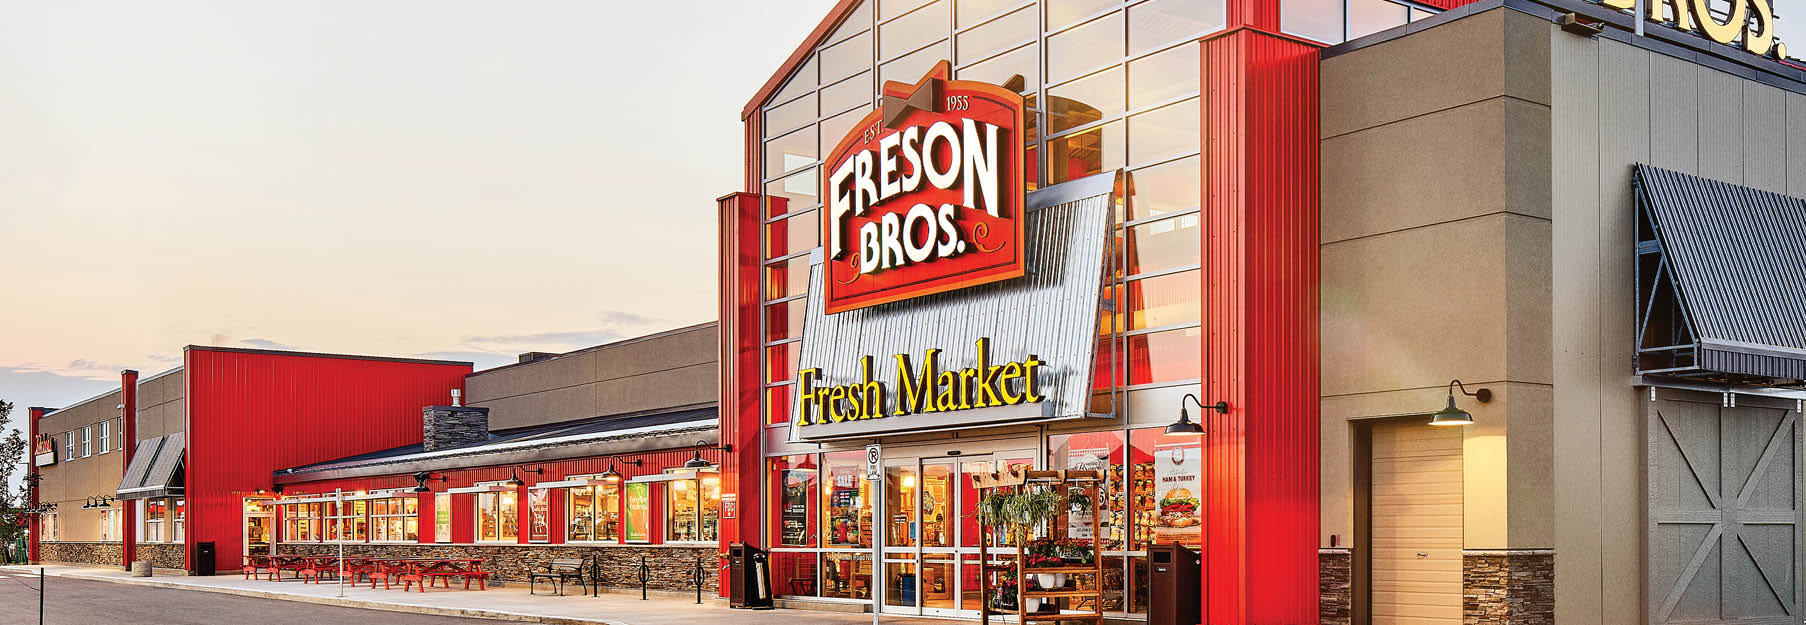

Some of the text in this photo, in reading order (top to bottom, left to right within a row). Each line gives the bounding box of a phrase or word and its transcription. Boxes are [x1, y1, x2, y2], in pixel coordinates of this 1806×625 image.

[946, 95, 969, 111] 1955
[829, 117, 1000, 260] FRESON
[860, 203, 966, 275] BROS.
[797, 337, 1046, 426] Fresh Market
